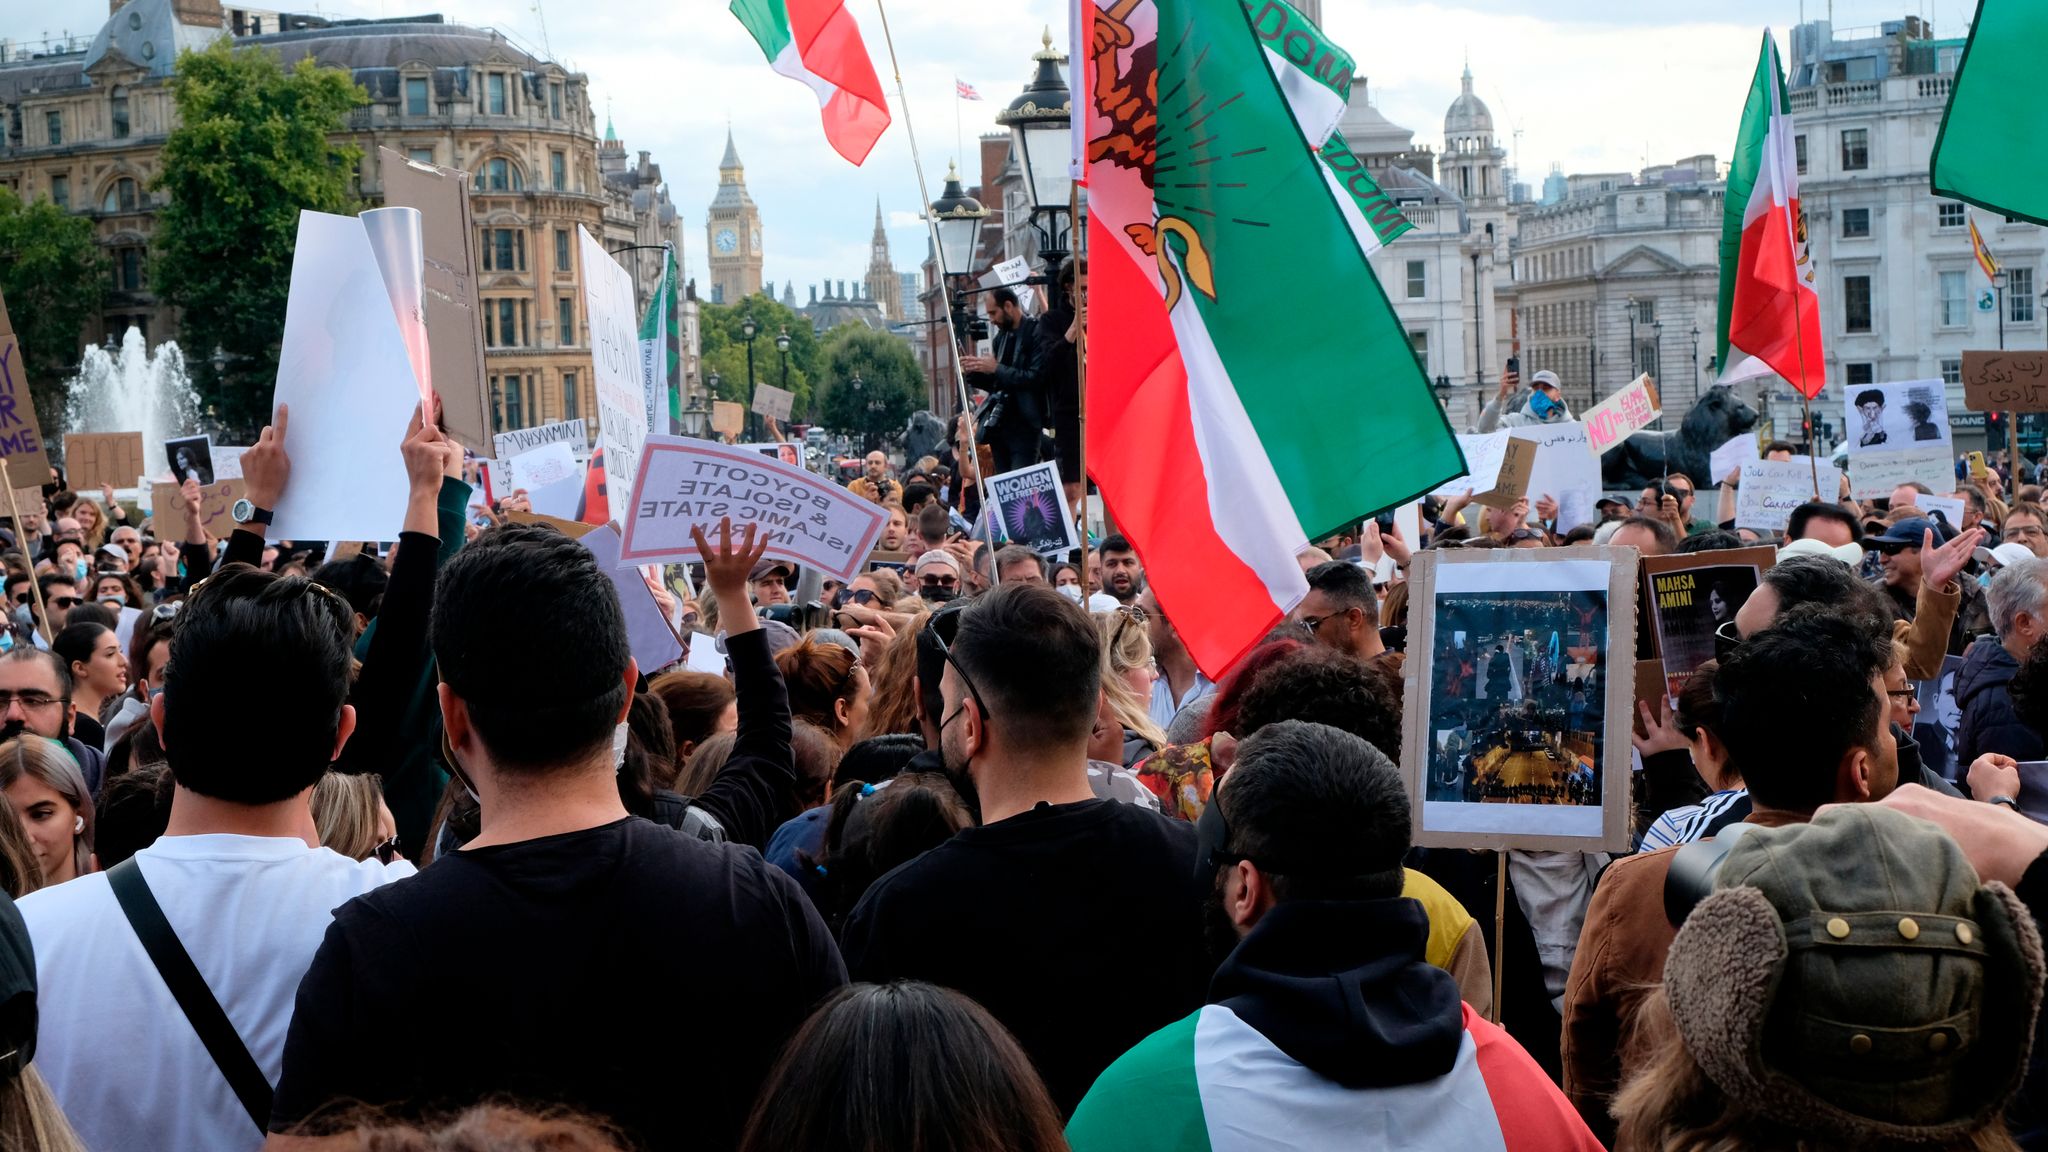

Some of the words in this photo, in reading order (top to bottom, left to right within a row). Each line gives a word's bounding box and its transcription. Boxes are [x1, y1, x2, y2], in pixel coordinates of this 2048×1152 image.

[1247, 0, 1351, 93] DOM
[1969, 357, 2013, 386] زندگی
[2012, 356, 2043, 378] زن
[1587, 408, 1617, 450] NO
[1501, 463, 1515, 476] ER
[995, 469, 1053, 496] WOMEN
[999, 492, 1017, 503] LIFE
[1016, 482, 1054, 499] FREEDOM
[1657, 574, 1696, 592] MAHSA
[1660, 591, 1692, 608] AMINI
